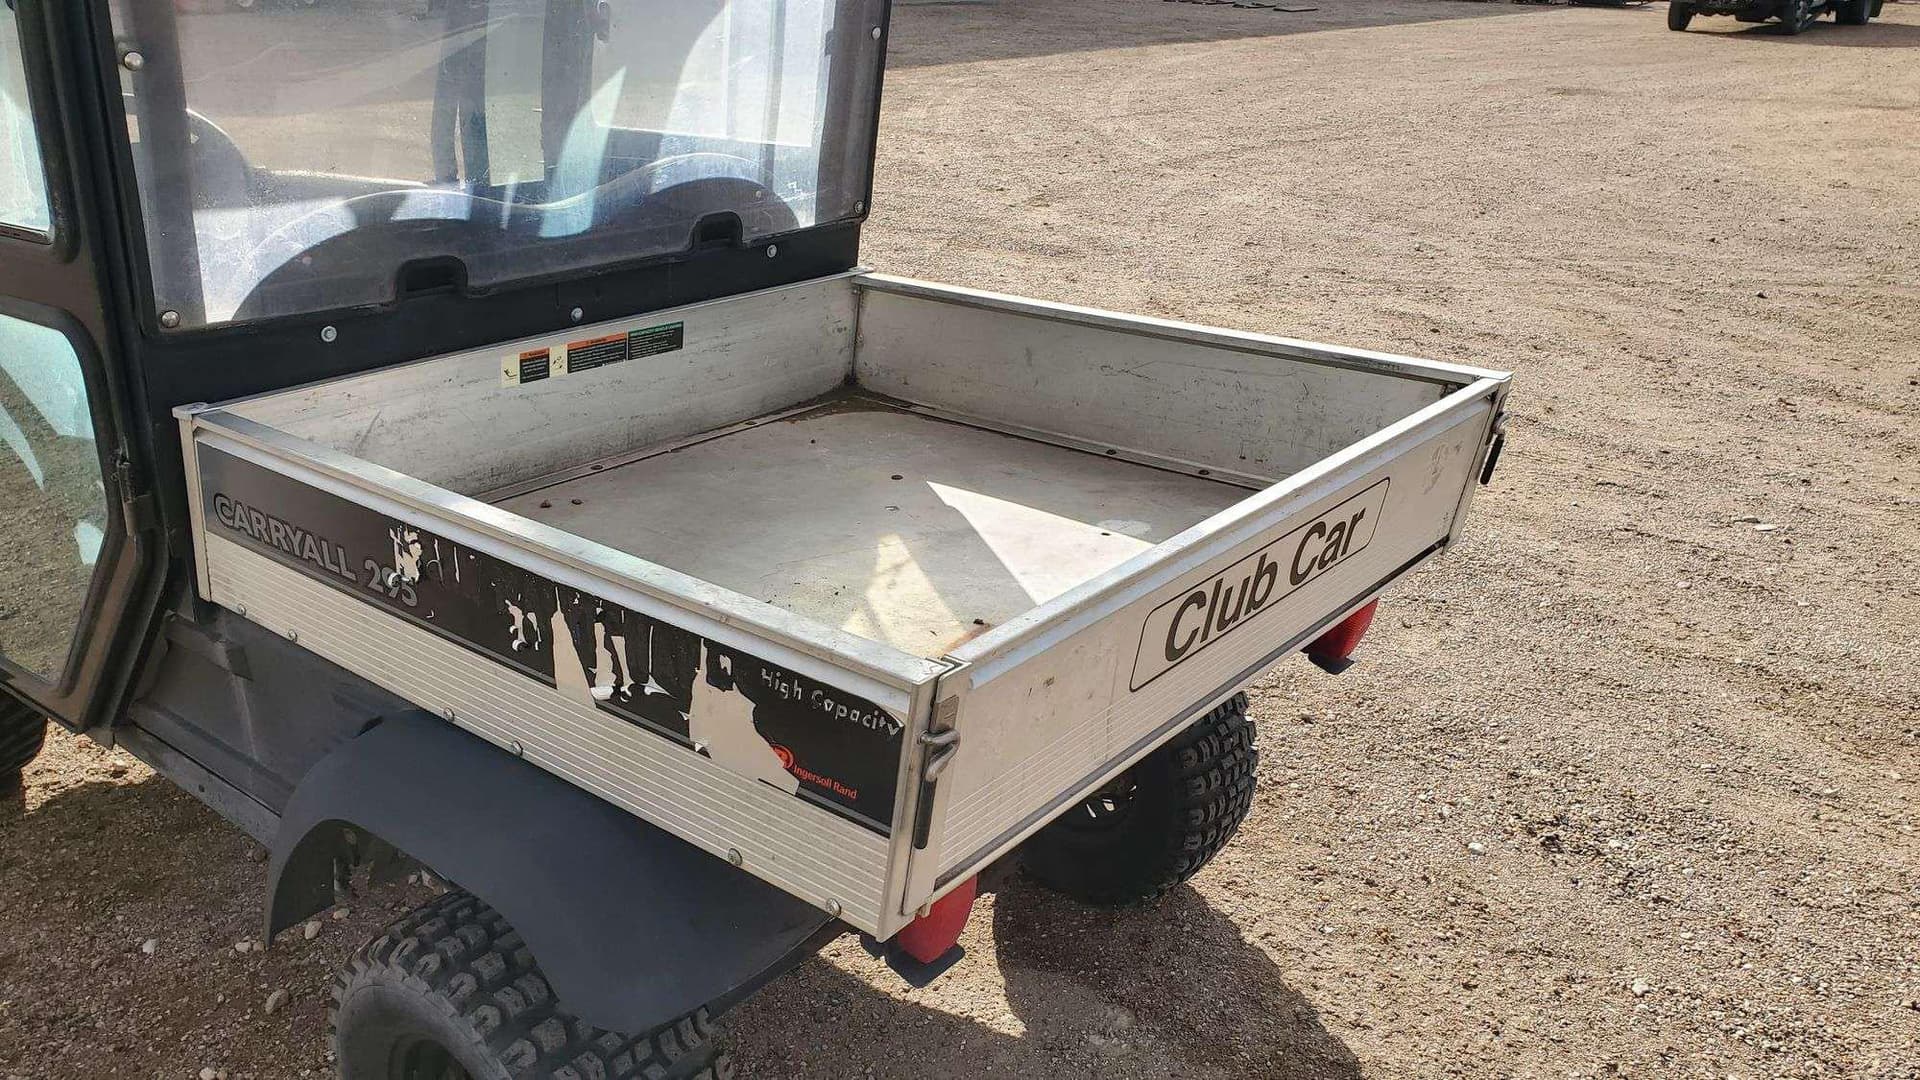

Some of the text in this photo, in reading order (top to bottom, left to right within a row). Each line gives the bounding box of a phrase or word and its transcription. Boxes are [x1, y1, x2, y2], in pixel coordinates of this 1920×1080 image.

[213, 492, 357, 581] CARRYALL
[1165, 507, 1367, 662] Club Car
[761, 668, 900, 736] High Capacity
[794, 765, 858, 799] Ingersoll Rand
